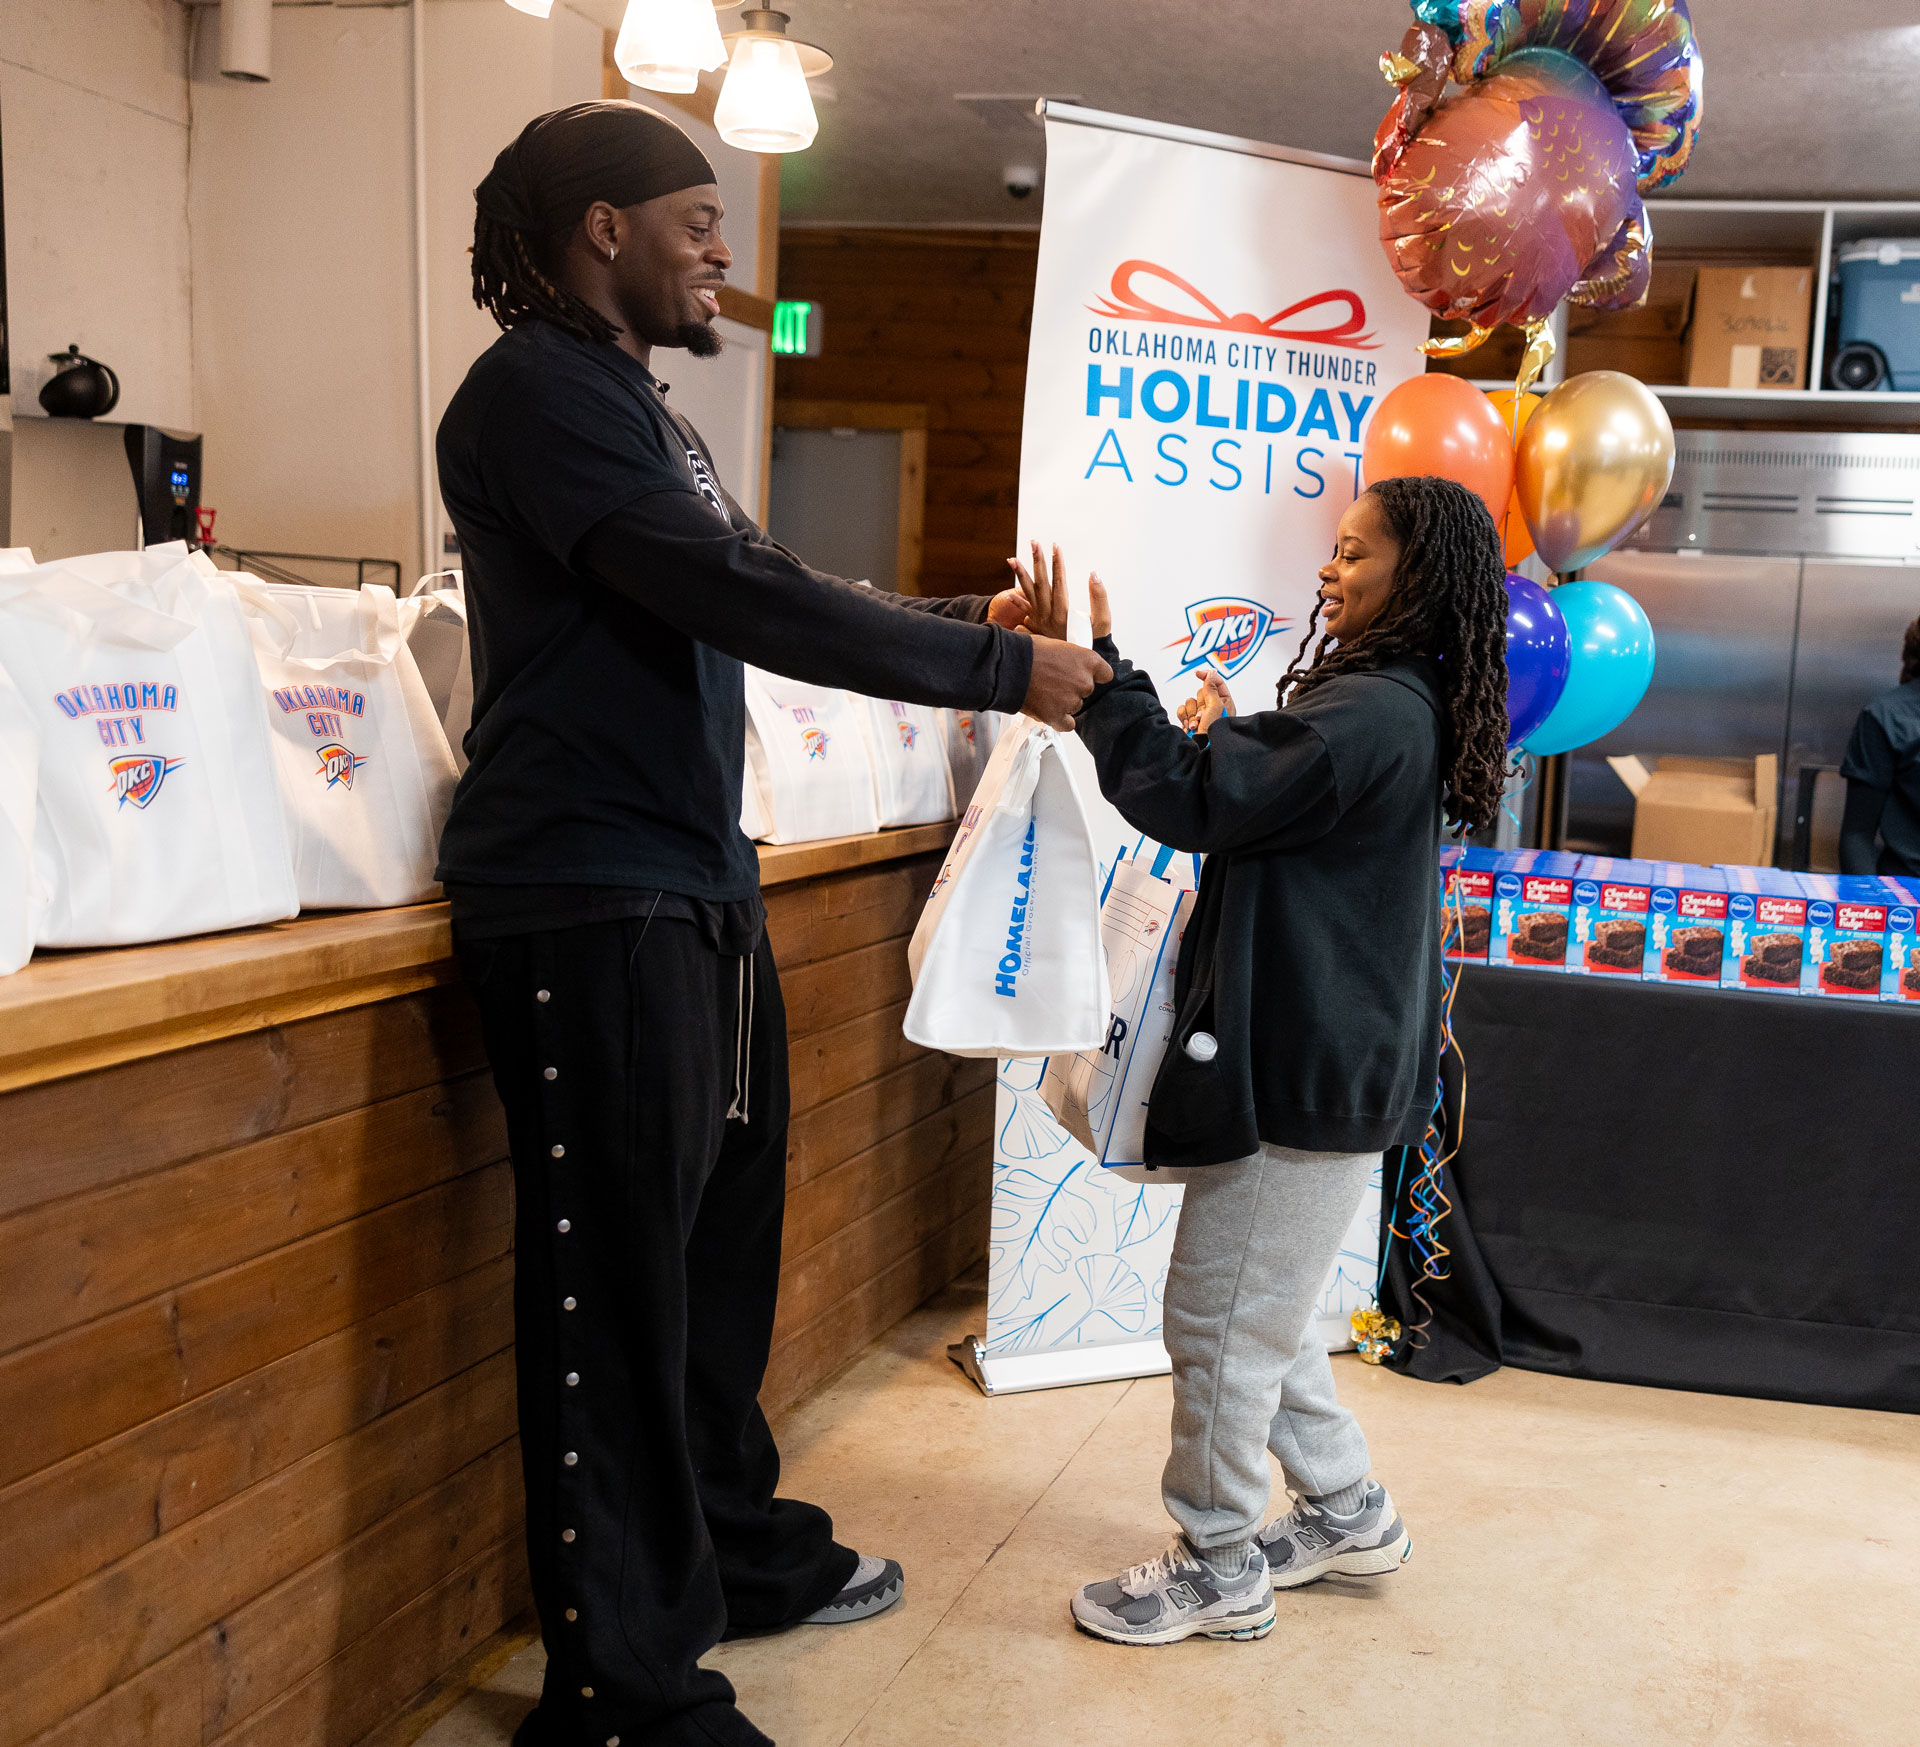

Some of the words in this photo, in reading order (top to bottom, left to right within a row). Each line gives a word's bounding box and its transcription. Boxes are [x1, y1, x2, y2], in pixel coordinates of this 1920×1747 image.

[1089, 328, 1216, 365] OKLAHOMA
[1228, 342, 1277, 372] CITY
[1286, 350, 1376, 387] THUNDER
[1086, 363, 1375, 443] HOLIDAY
[1084, 428, 1362, 501] ASSIST
[1182, 612, 1256, 665] OKC
[54, 681, 179, 720] OKLAHOMA
[273, 685, 366, 718] OKLAHOMA
[96, 715, 146, 748] CITY
[306, 712, 344, 738] CITY
[116, 762, 151, 801] OKC
[1526, 880, 1569, 893] Chocolate
[1604, 888, 1647, 900] Chocolate
[1682, 894, 1724, 907] Chocolate
[1026, 887, 1036, 932] Grocery
[1760, 901, 1803, 913] Chocolate
[1839, 907, 1883, 920] Chocolate
[1021, 936, 1032, 977] Official
